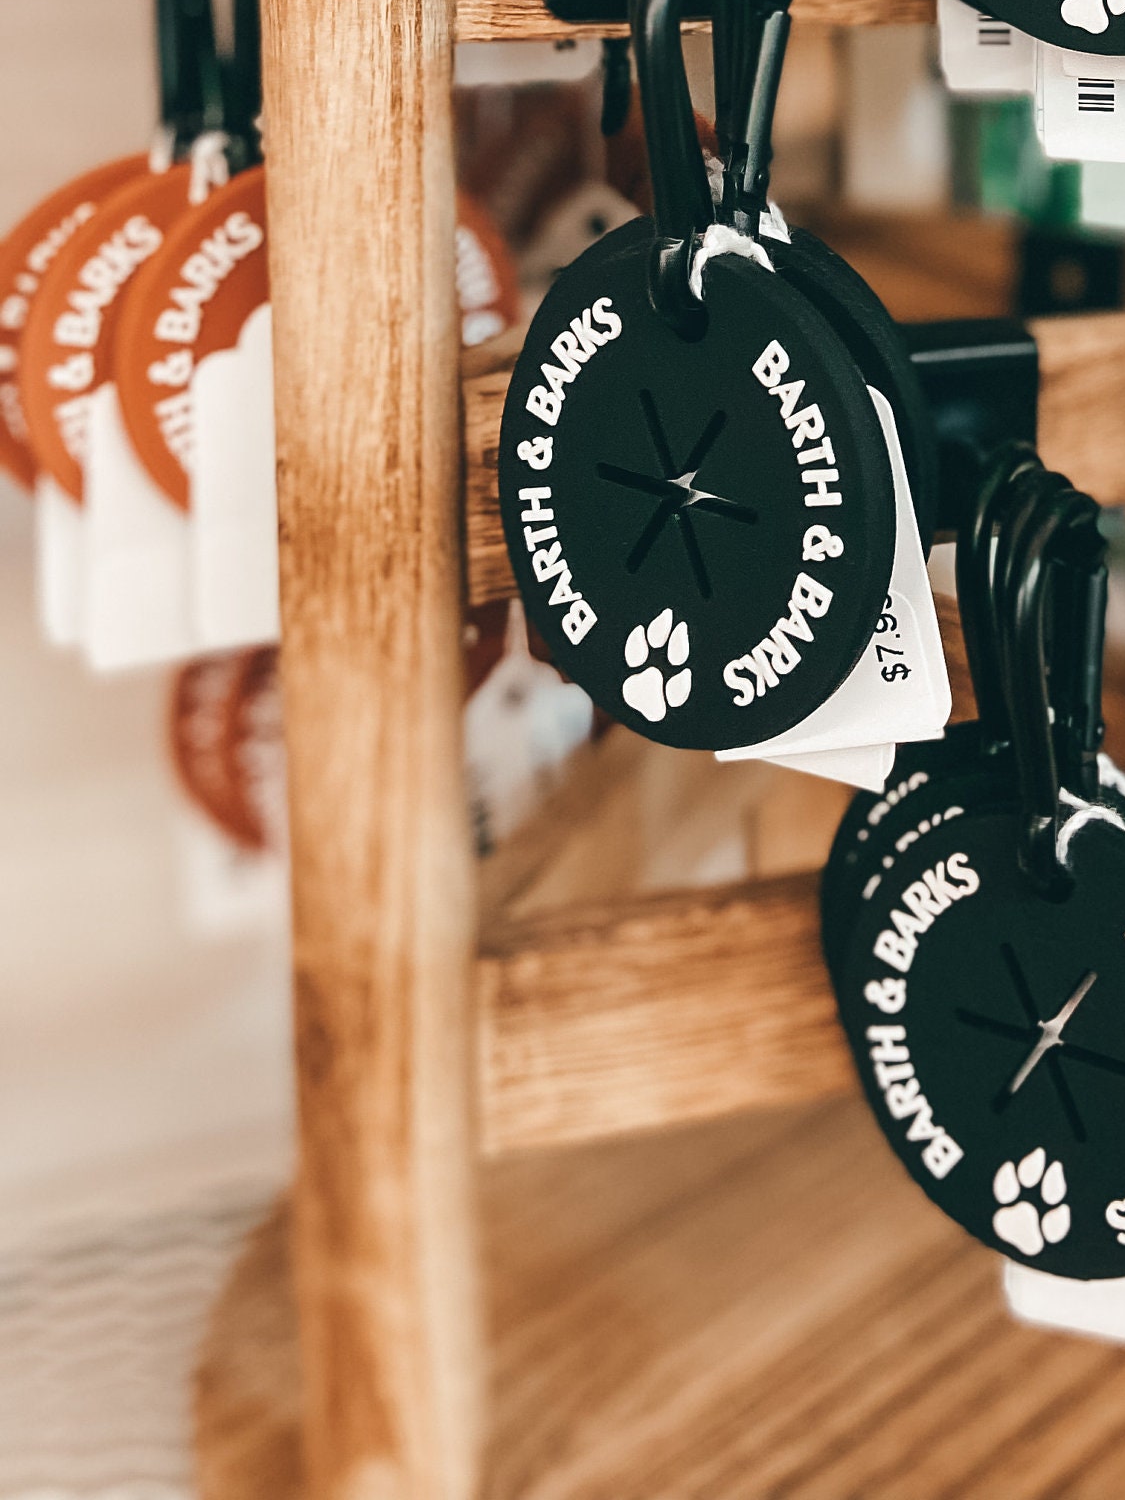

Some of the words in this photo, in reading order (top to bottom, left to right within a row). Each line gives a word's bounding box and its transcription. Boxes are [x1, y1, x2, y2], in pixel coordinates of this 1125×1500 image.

[525, 297, 622, 426] BARKS
[752, 340, 842, 506] BARTH
[517, 437, 553, 470] &
[518, 487, 597, 645] BARTH
[803, 525, 844, 561] &
[723, 572, 834, 706] BARKS
[875, 594, 912, 682] $7.9
[873, 853, 979, 972] BARKS
[865, 978, 906, 1013] &
[866, 1026, 963, 1180] BARTH
